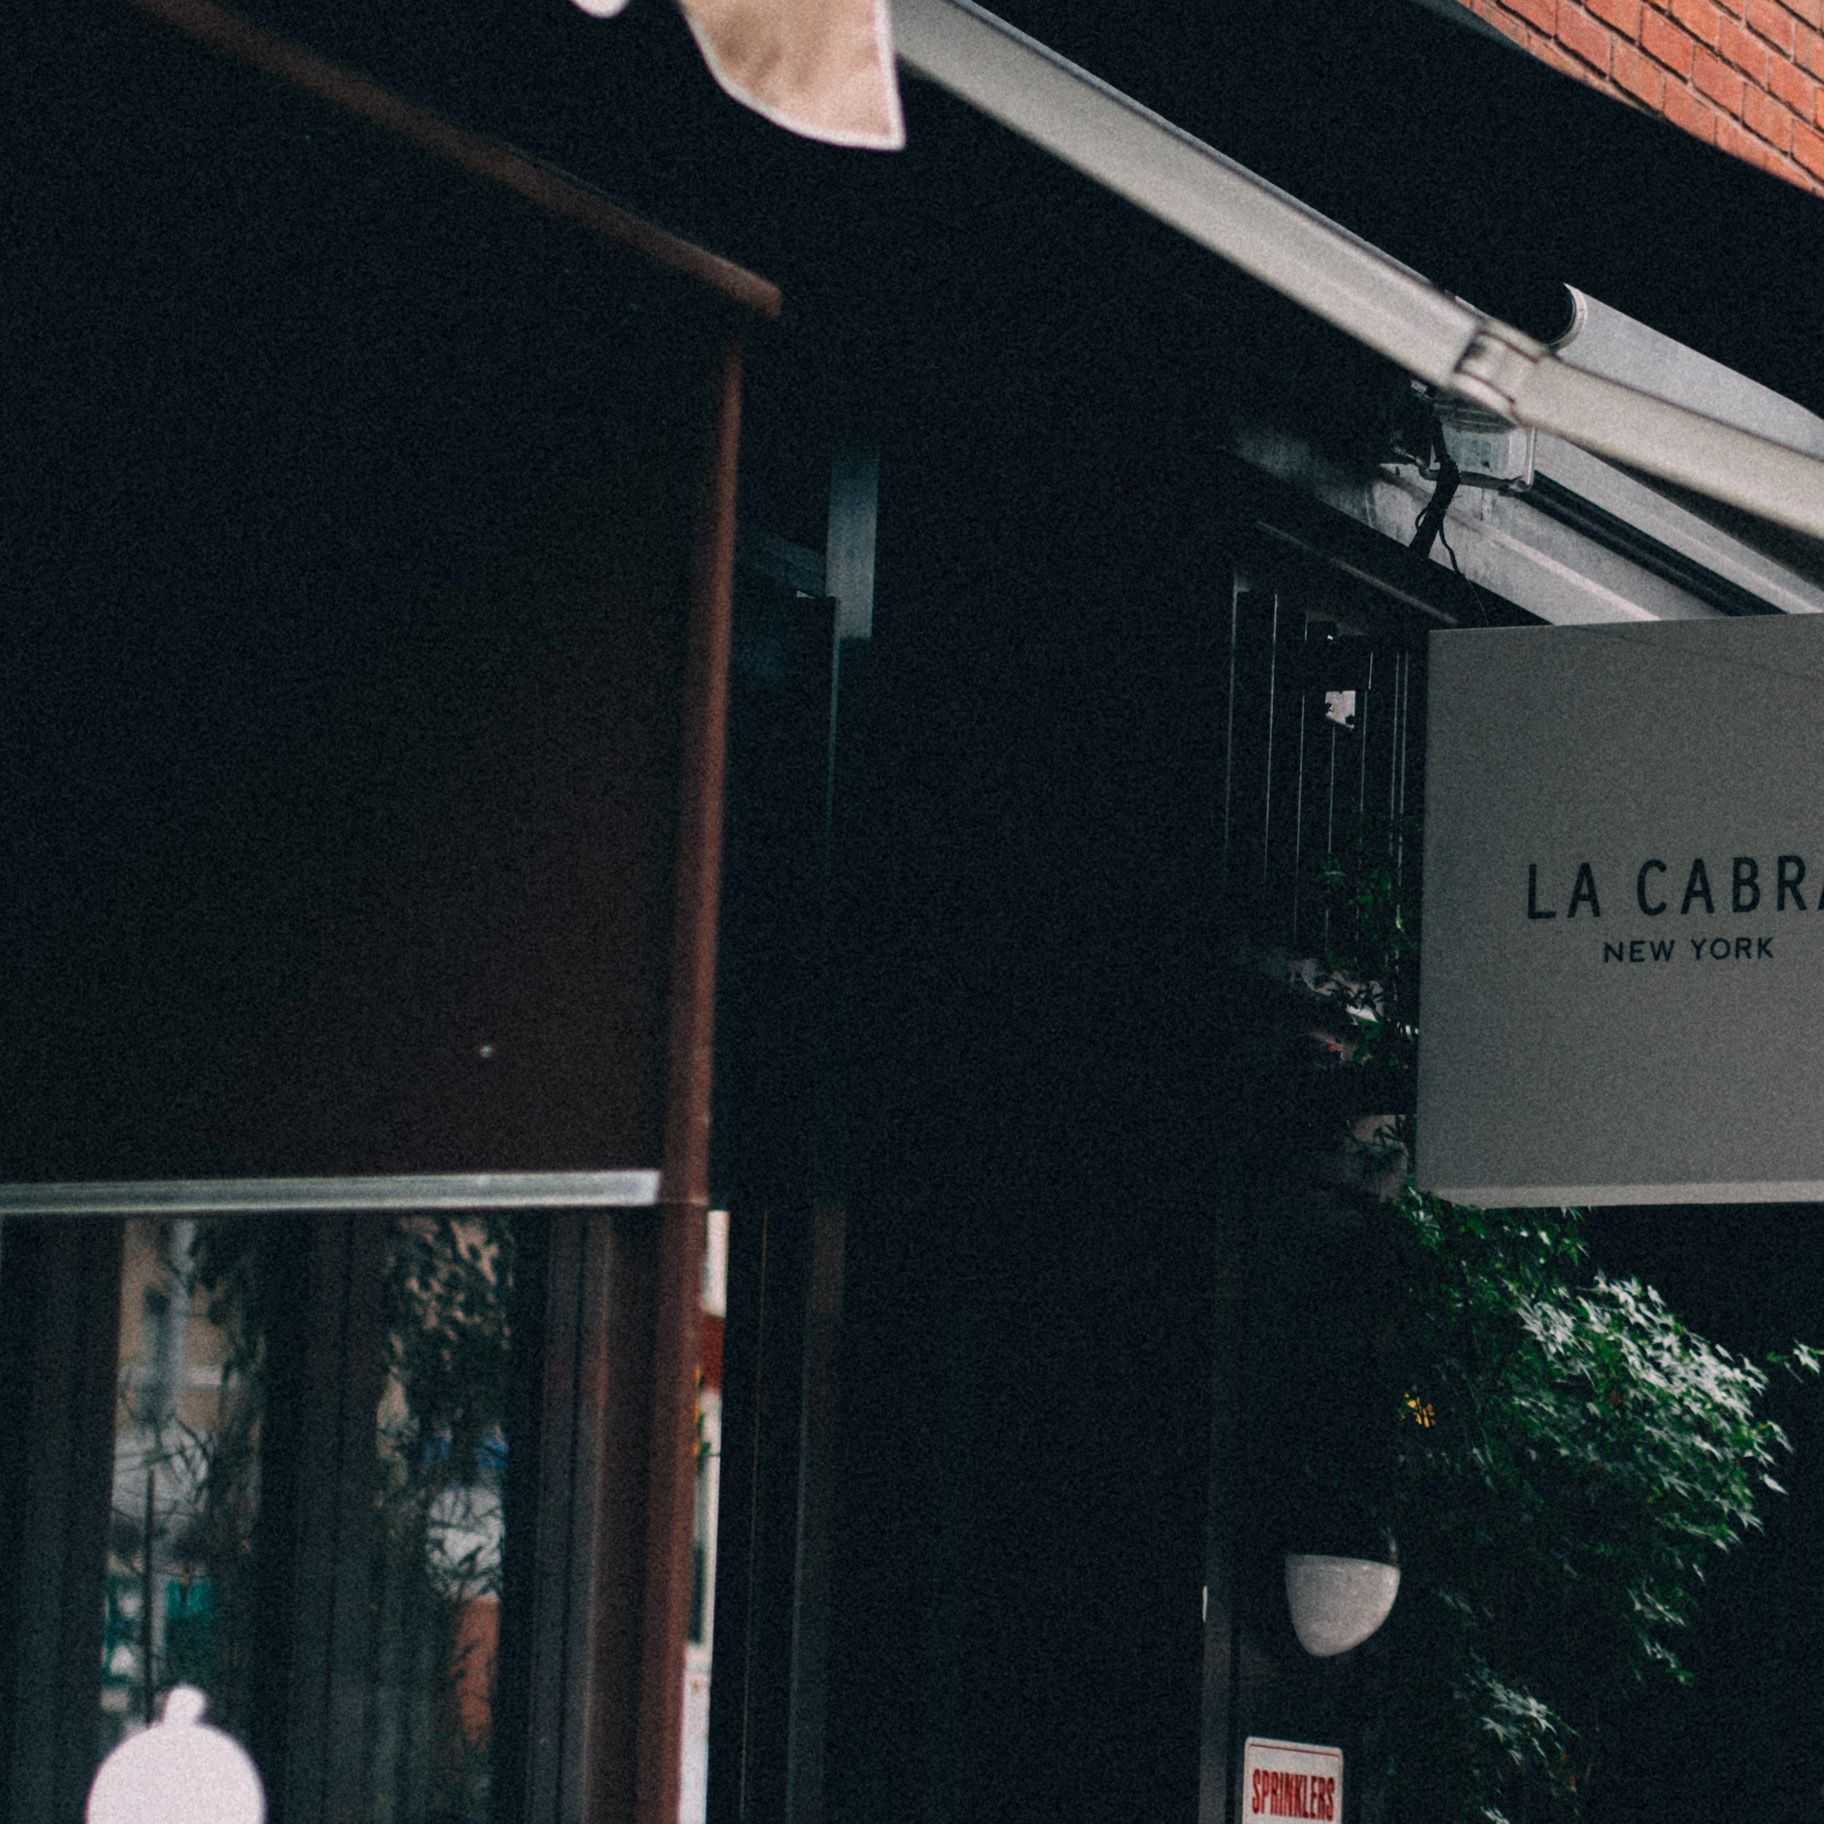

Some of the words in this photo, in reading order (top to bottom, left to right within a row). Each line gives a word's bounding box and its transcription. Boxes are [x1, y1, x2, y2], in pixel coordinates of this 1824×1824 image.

[1527, 861, 1602, 921] LA
[1602, 938, 1673, 964] NEW
[1690, 935, 1775, 961] YORK
[1252, 1769, 1335, 1821] SPRINKLERS
